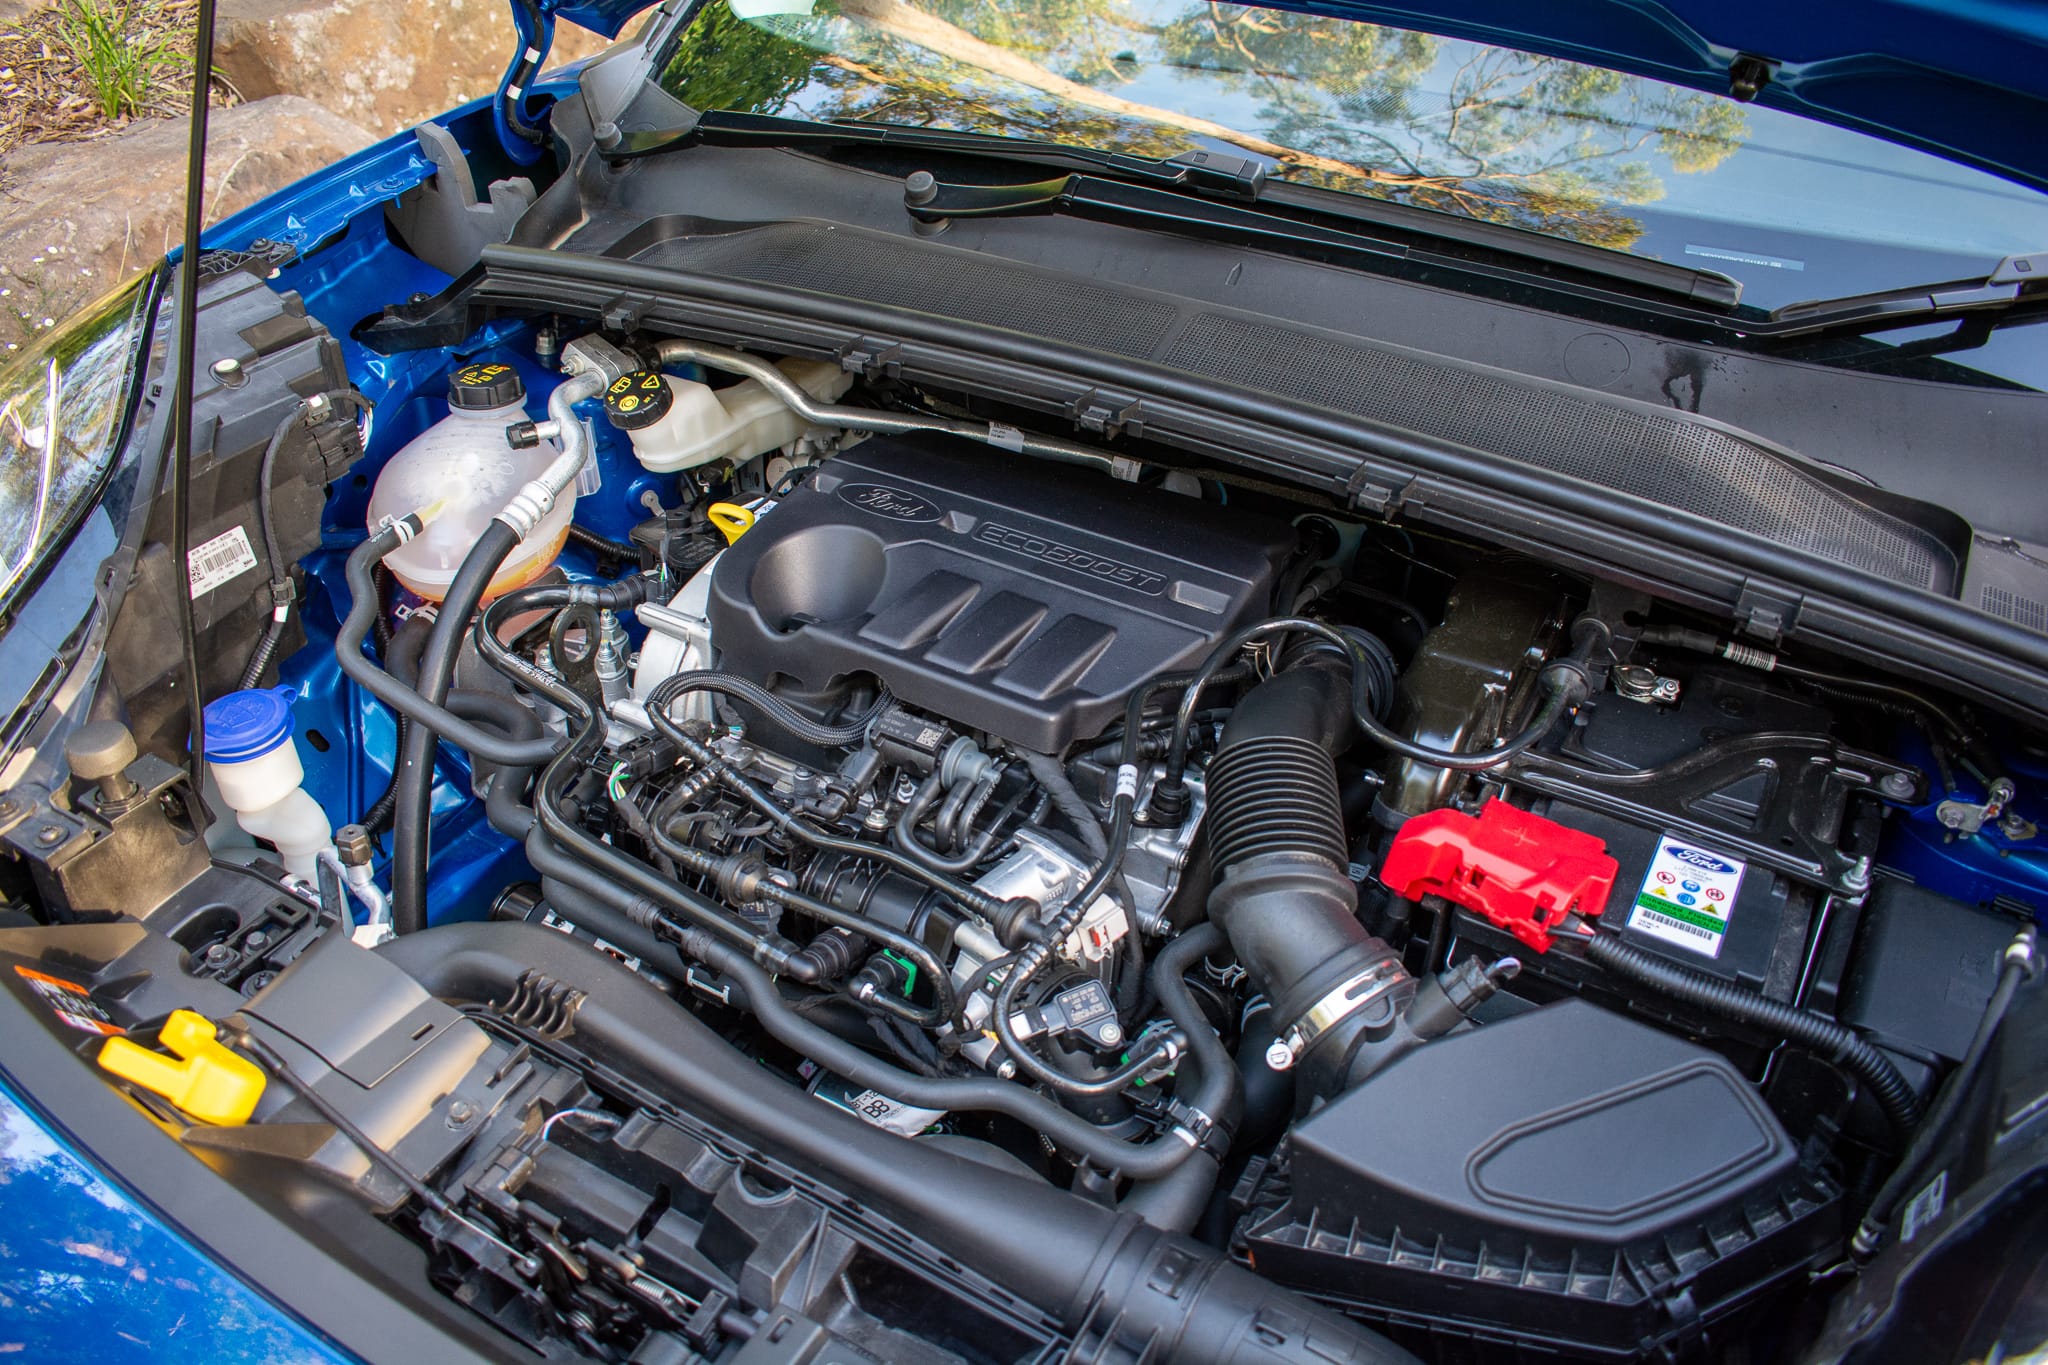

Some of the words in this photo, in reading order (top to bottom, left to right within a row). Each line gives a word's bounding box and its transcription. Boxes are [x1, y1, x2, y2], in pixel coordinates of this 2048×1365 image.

[858, 487, 919, 518] Ford
[980, 523, 1164, 588] ECOBOOST
[1677, 850, 1722, 871] Ford
[862, 1099, 890, 1119] BB
